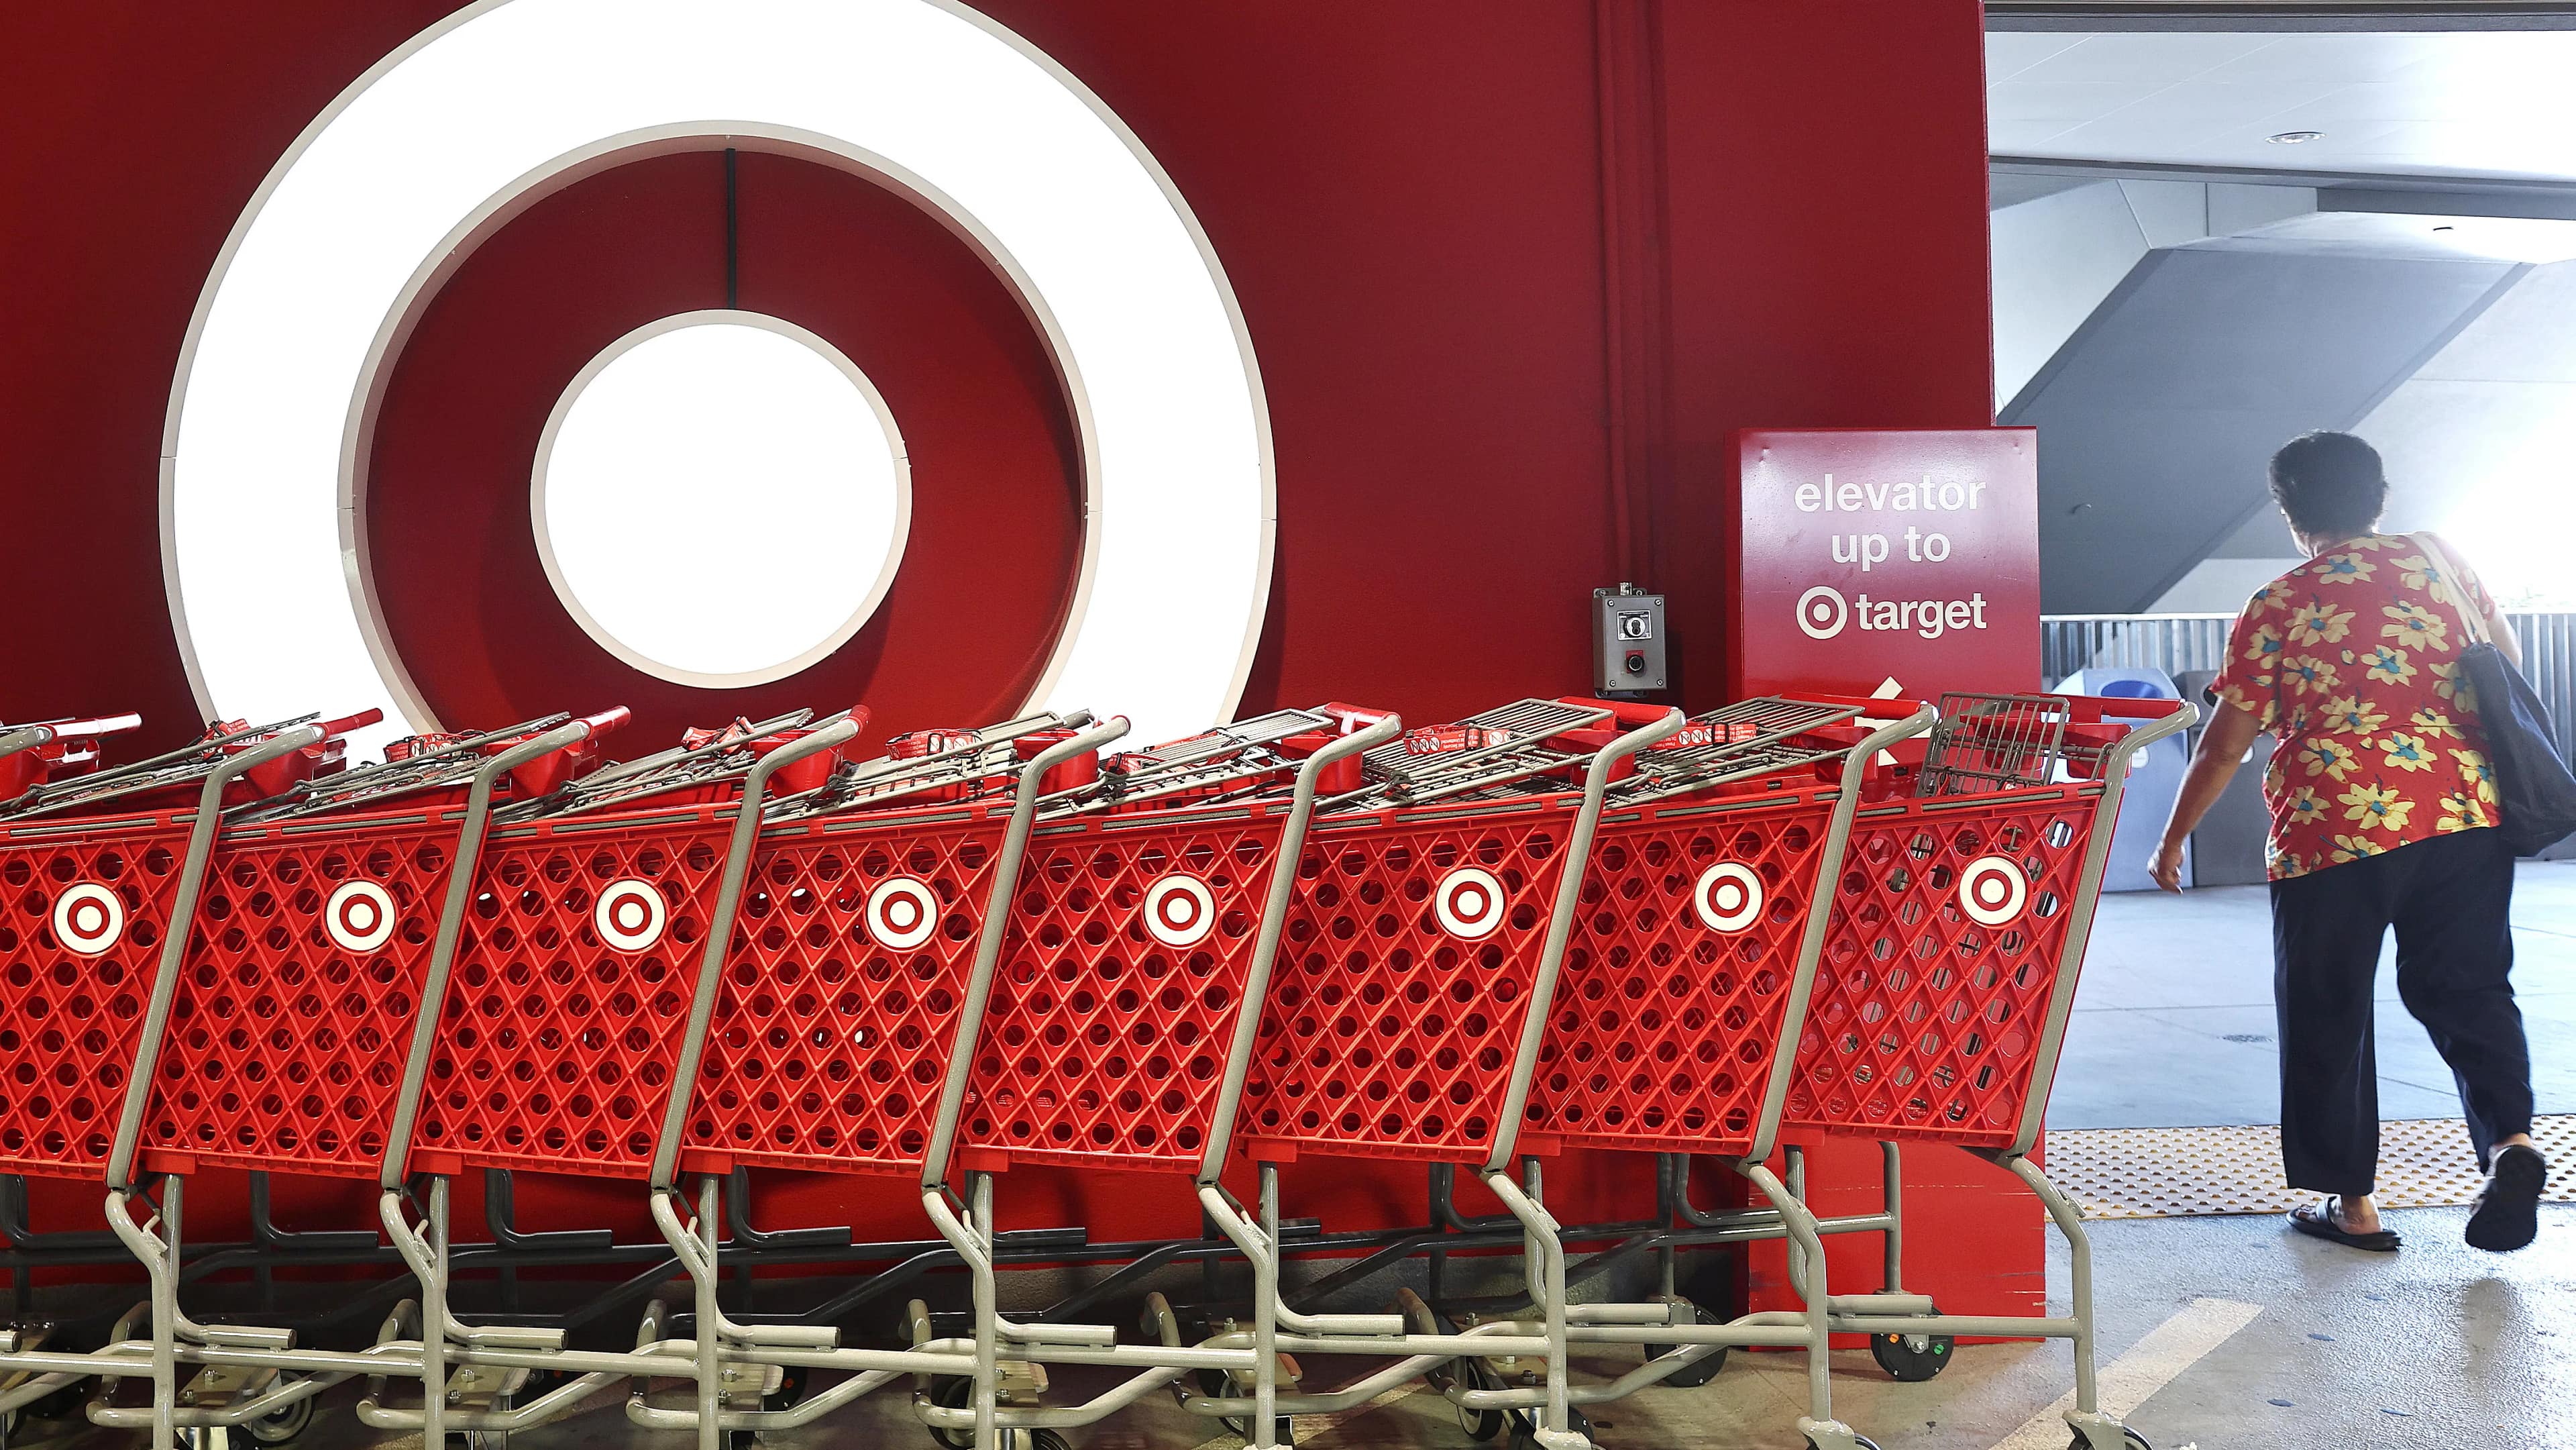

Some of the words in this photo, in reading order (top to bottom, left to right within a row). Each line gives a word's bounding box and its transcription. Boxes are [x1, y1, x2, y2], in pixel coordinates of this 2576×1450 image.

[1794, 473, 1986, 512] elevator
[1831, 533, 1890, 572] up
[1904, 526, 1951, 562] to
[1855, 592, 1987, 639] target
